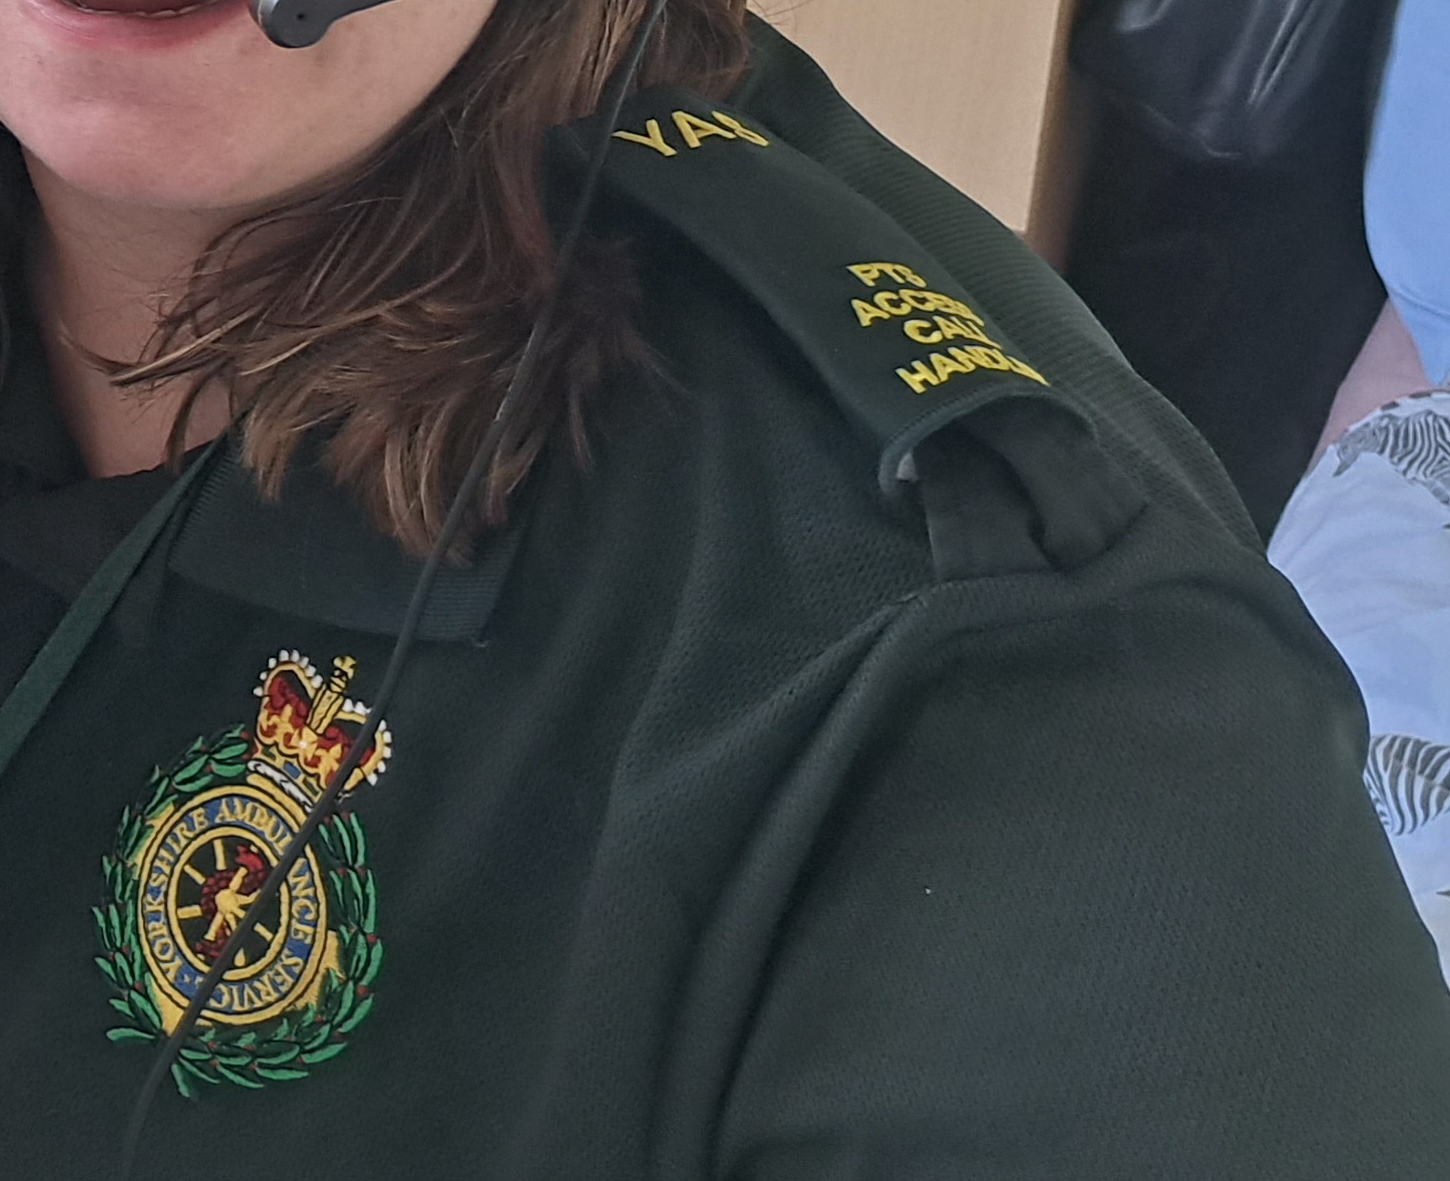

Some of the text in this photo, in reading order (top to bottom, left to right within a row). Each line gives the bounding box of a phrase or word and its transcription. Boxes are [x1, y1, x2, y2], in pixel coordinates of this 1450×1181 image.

[612, 110, 769, 157] YAS
[846, 262, 927, 288] PTS
[142, 805, 210, 985] YORKSHIRE
[214, 796, 319, 945] AMBULNCE
